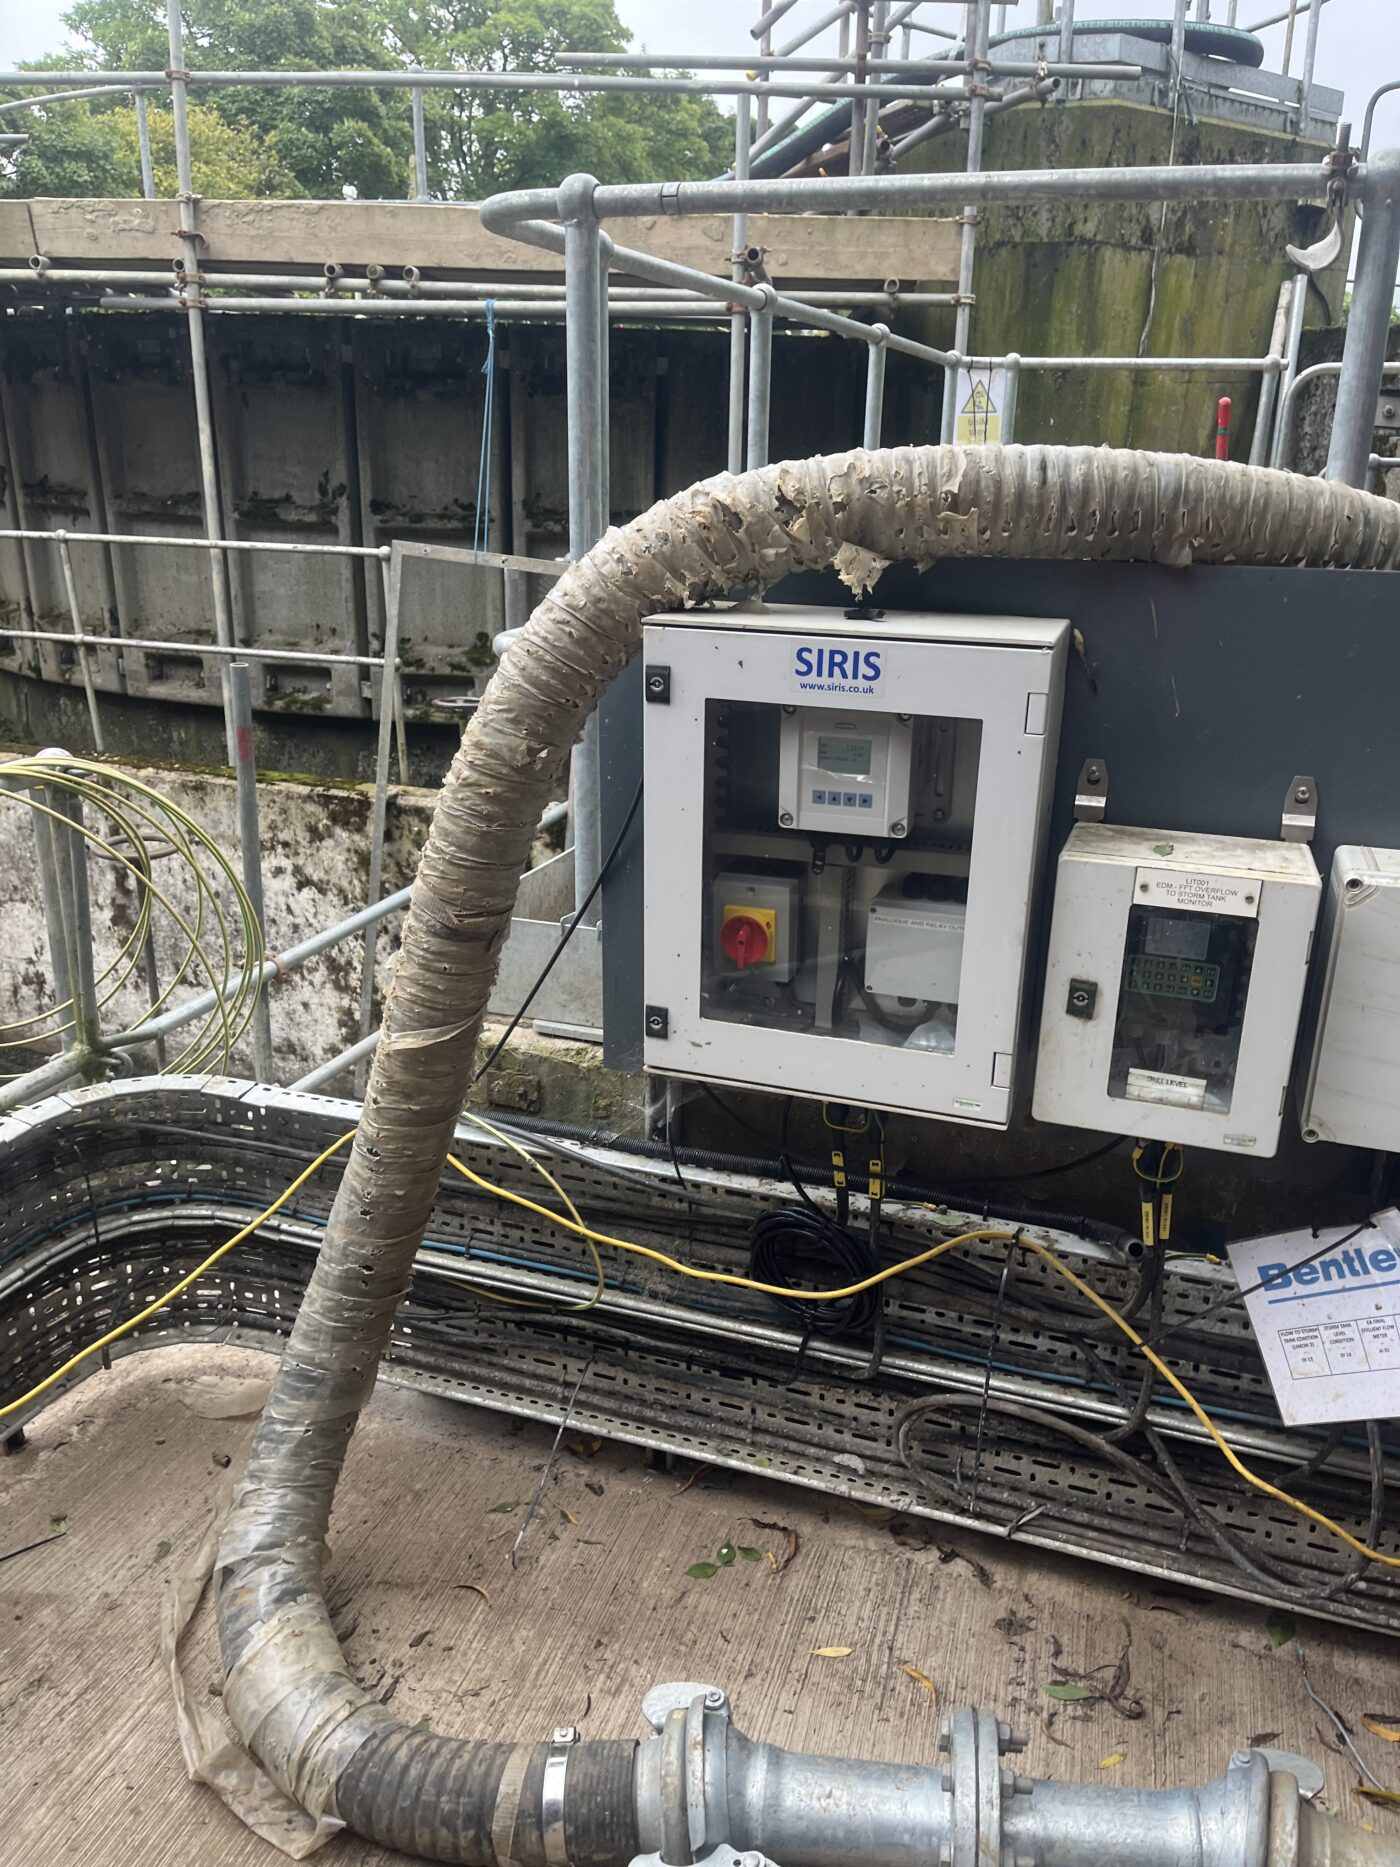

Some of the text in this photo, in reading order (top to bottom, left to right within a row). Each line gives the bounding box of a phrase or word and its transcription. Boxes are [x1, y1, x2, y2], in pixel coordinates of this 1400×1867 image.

[1107, 20, 1156, 29] SUCTION
[795, 647, 881, 682] SIRIS
[799, 682, 874, 694] www.siris.co.uk
[1185, 878, 1209, 887] LIT001
[1179, 884, 1192, 892] FFT
[1195, 886, 1238, 896] OVERFLOW
[1166, 889, 1227, 902] TO STORM TANK
[1177, 898, 1212, 907] MONITOR
[874, 916, 909, 925] ANALOGUE
[1165, 1079, 1188, 1089] LEVEL
[1329, 1337, 1354, 1345] CONDITION
